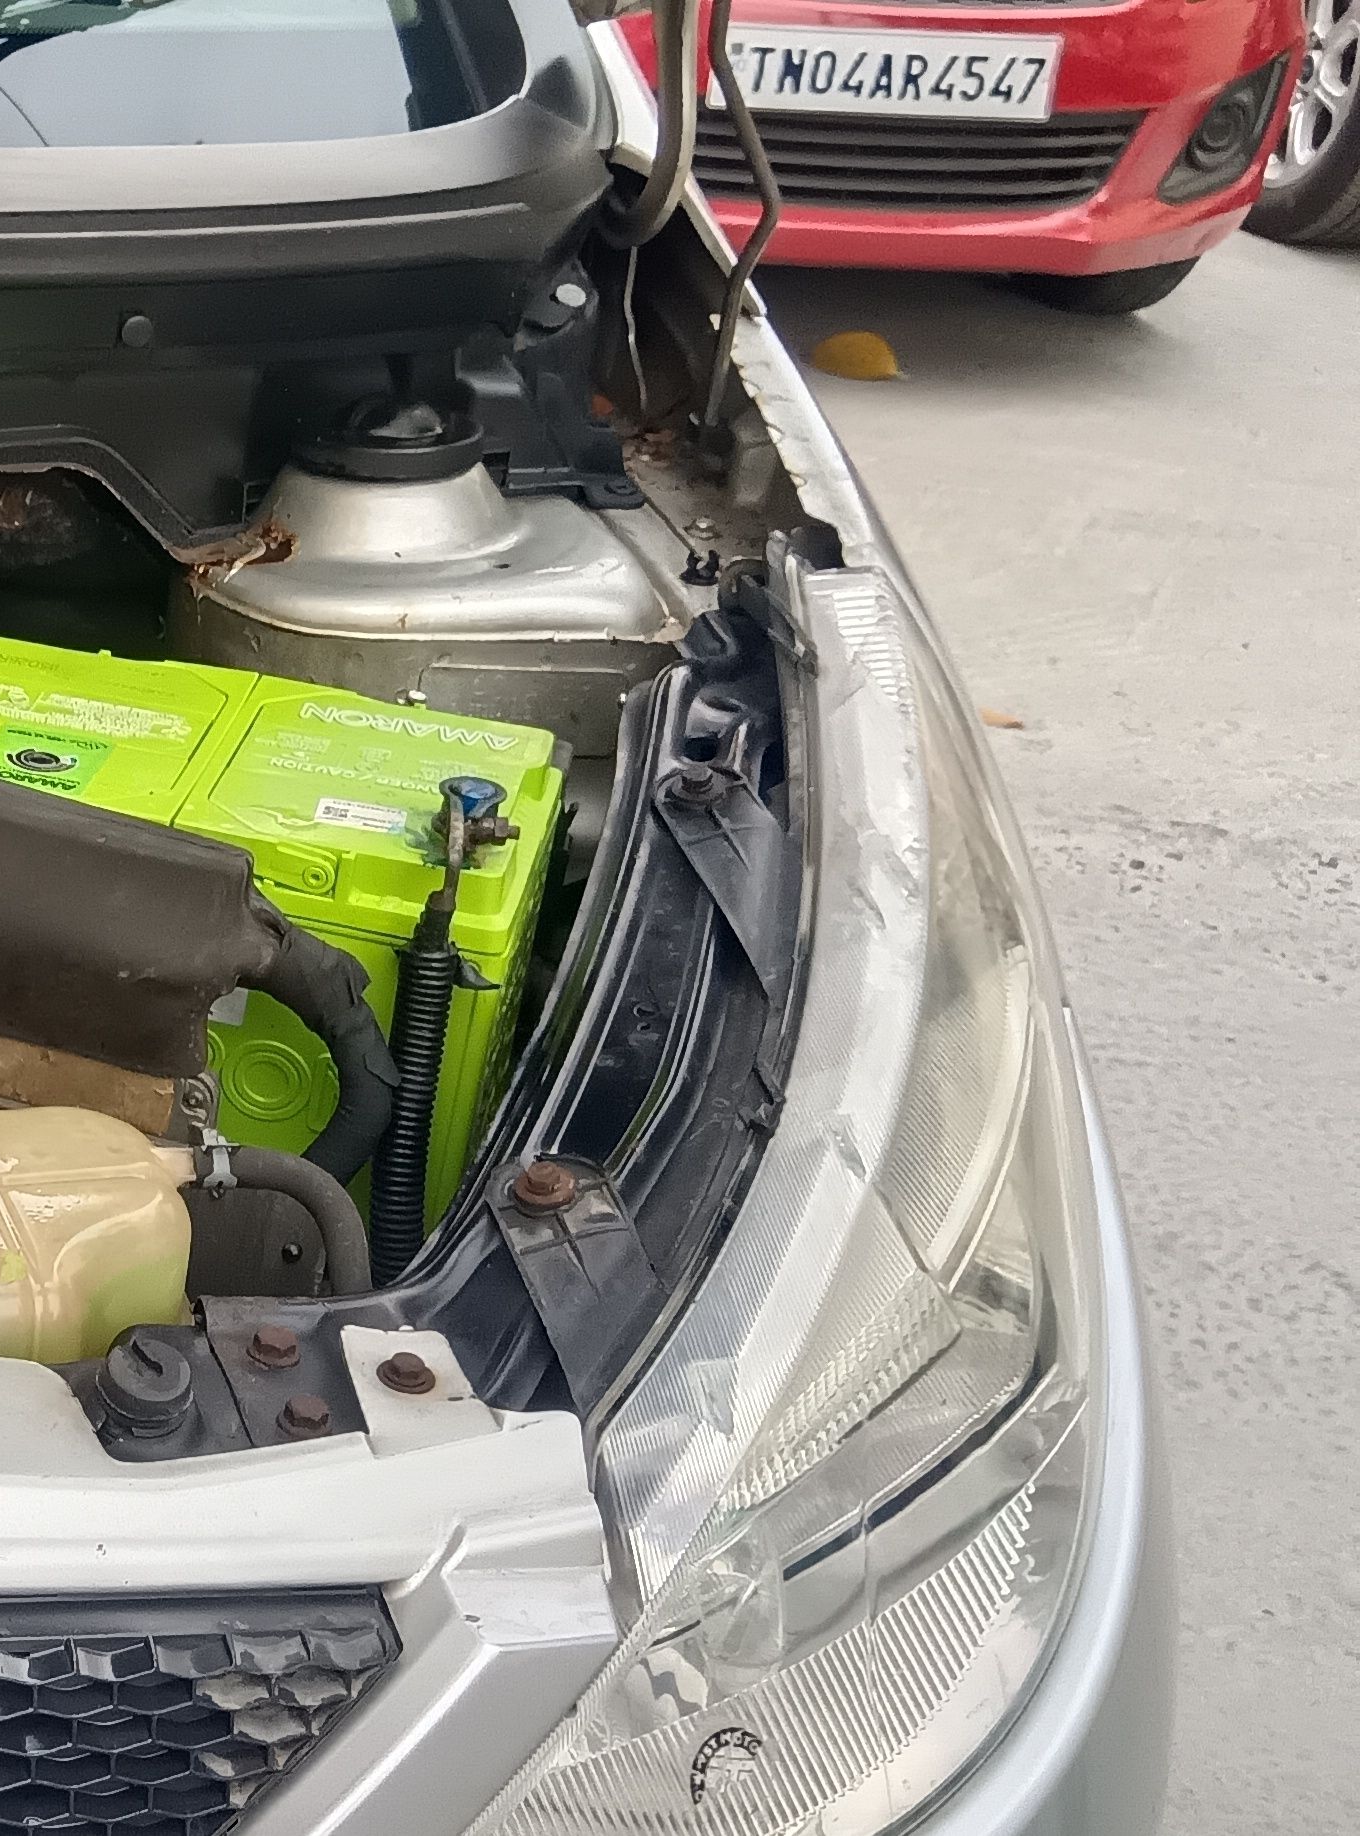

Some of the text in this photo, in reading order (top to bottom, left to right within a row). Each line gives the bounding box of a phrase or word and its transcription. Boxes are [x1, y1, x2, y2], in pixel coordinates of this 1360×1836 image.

[750, 46, 1046, 104] TN04AR4547
[301, 703, 519, 751] AMARON
[270, 756, 356, 779] CAUTION
[377, 777, 440, 795] ANGER
